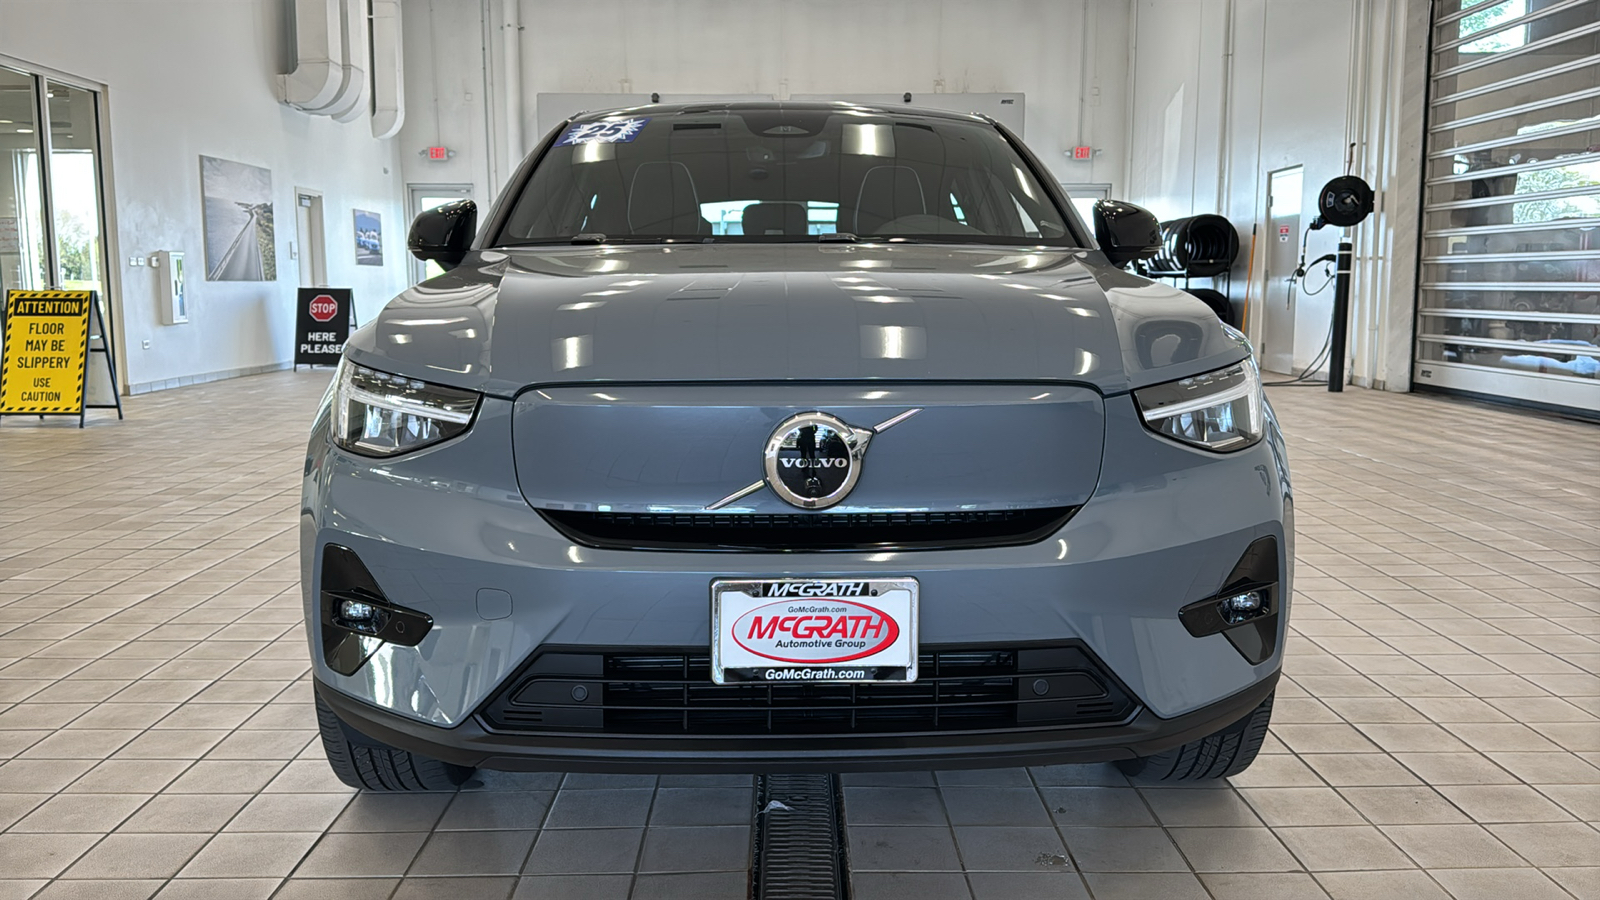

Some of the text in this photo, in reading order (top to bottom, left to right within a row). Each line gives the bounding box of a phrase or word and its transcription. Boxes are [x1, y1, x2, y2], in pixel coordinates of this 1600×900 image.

[577, 123, 628, 139] 25
[429, 147, 446, 159] EXIT
[1075, 147, 1090, 159] EXIT
[17, 301, 80, 314] ATTENTION
[311, 303, 336, 314] STOP
[29, 322, 65, 335] FLOOR
[307, 331, 337, 342] HERE
[25, 339, 66, 352] MAY BE
[300, 343, 343, 354] PLEASE
[17, 356, 70, 369] SLIPPERY
[33, 377, 51, 388] USE
[21, 391, 61, 402] CAUTION
[780, 458, 848, 468] VOLVO
[787, 606, 847, 614] GoMcGrath.com
[775, 639, 867, 650] Automotive Group
[765, 668, 865, 681] GoMcGrath.com
